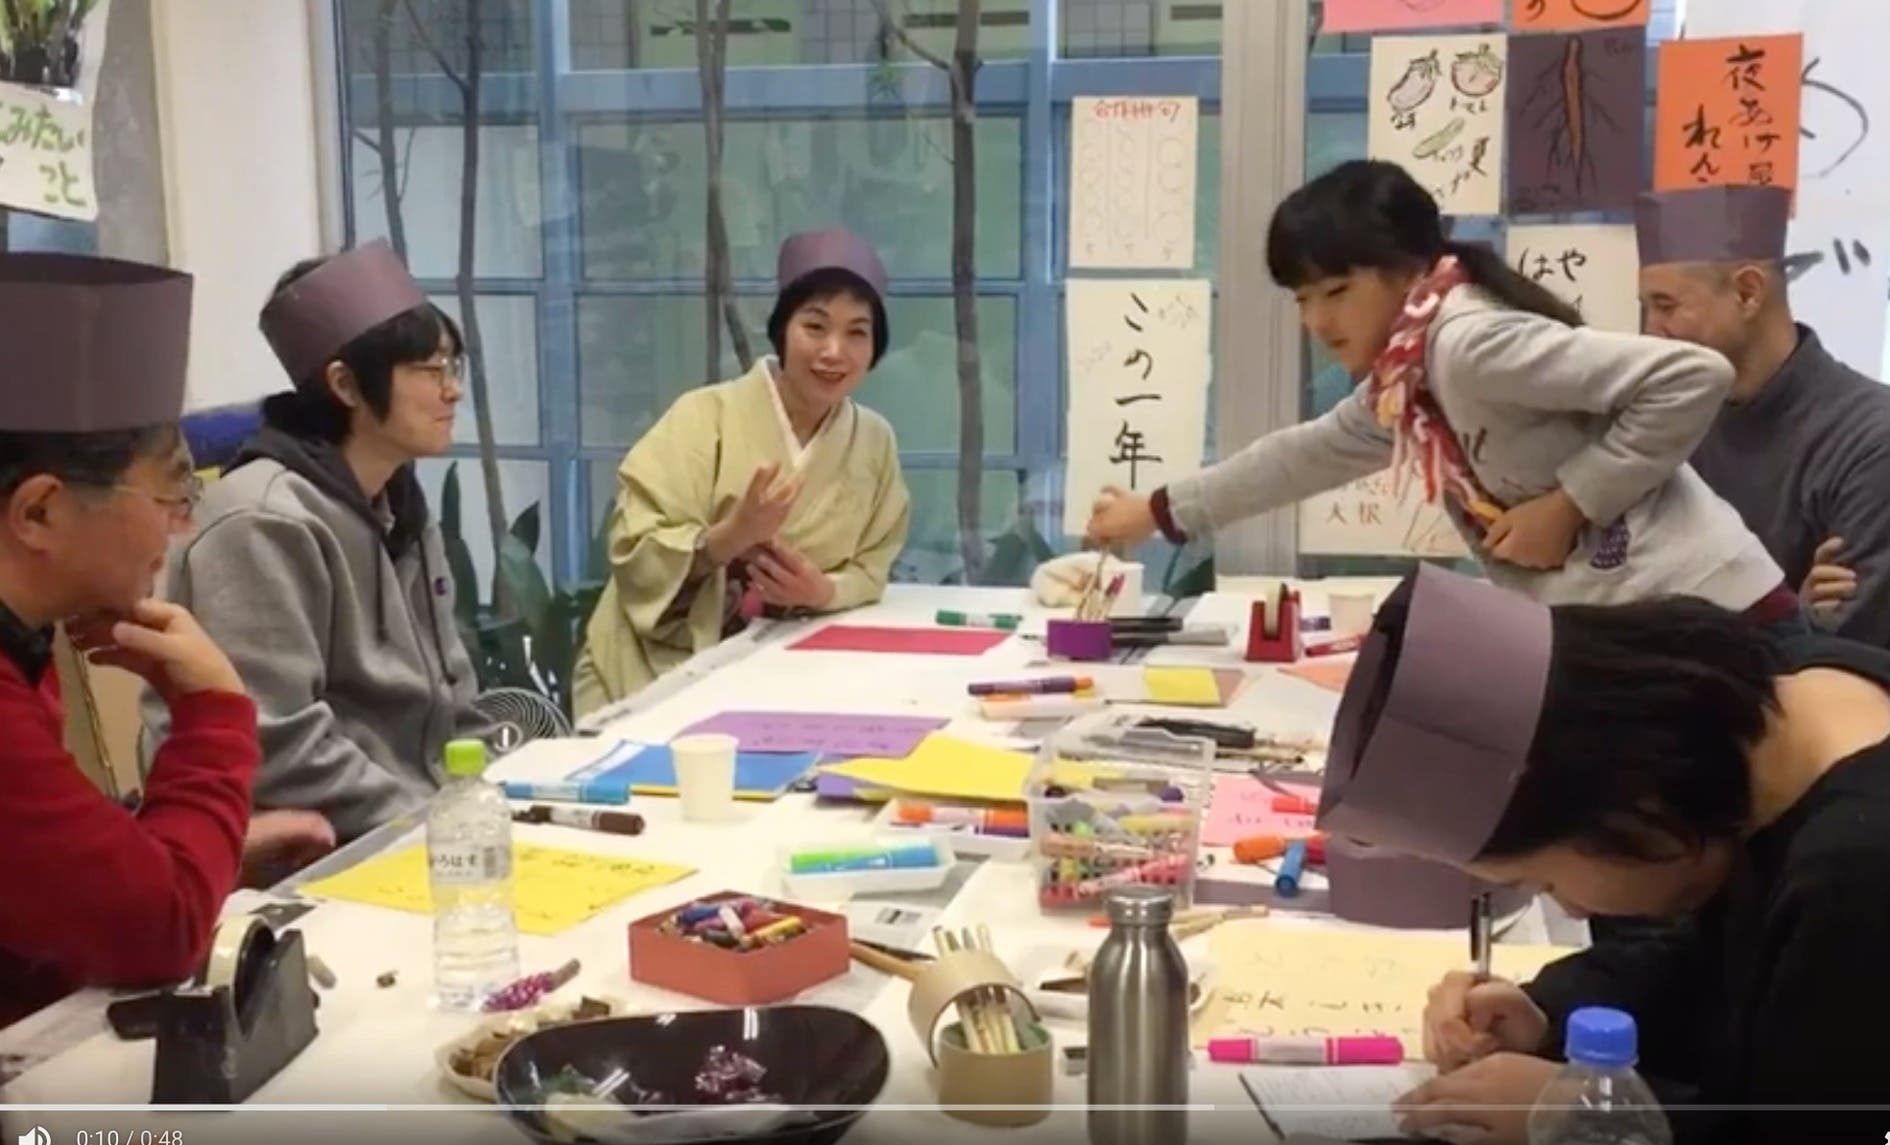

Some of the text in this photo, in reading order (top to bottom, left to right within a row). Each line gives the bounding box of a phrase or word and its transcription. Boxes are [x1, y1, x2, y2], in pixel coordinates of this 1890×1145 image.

[0, 102, 85, 151] みたい
[1109, 292, 1163, 489] この一年
